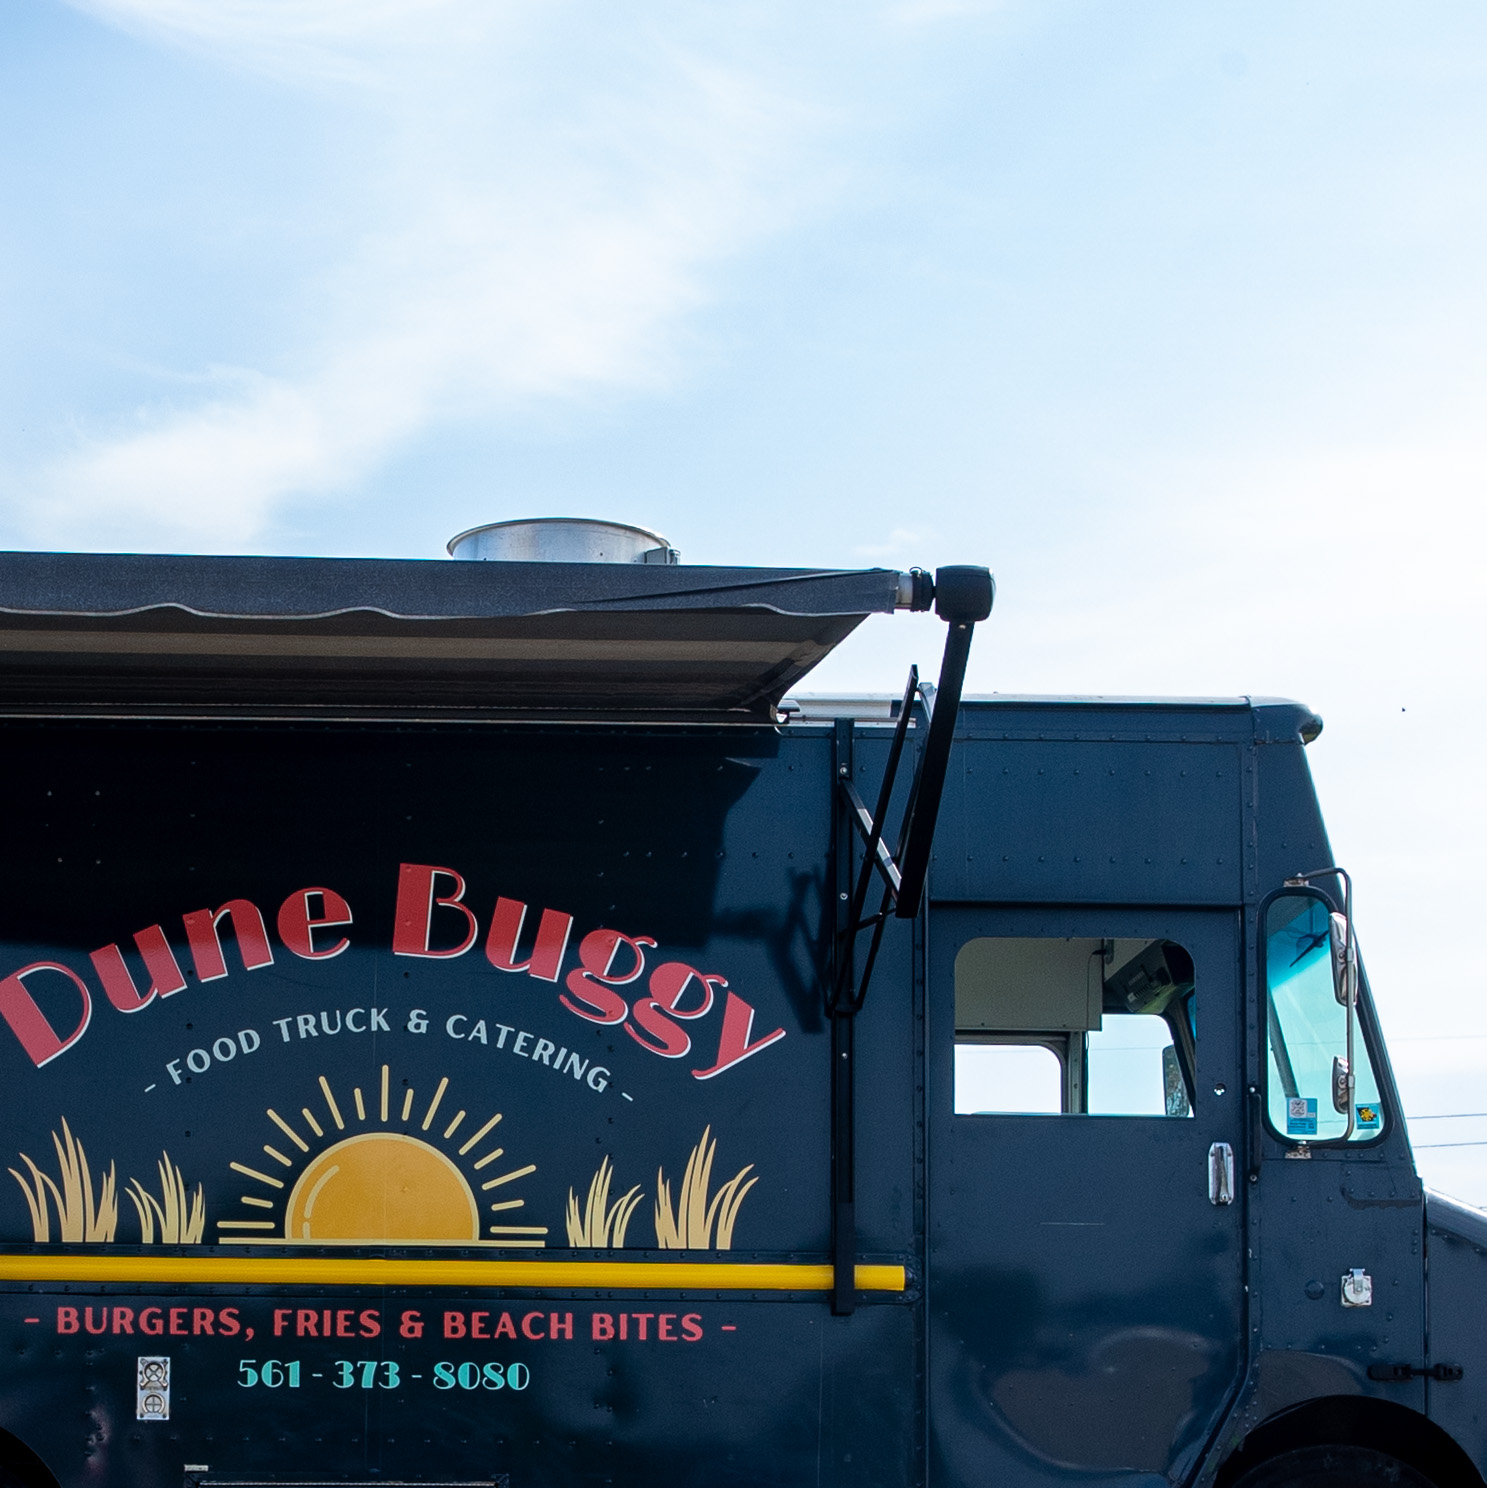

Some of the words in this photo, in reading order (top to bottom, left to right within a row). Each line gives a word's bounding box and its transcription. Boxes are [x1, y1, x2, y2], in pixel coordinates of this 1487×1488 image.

[393, 863, 787, 1080] Buggy
[166, 1030, 260, 1085] FOOD
[273, 1009, 390, 1042] TRUCK
[408, 1009, 429, 1034] &
[445, 1015, 611, 1093] CATERING
[58, 1307, 254, 1341] BURGERS,
[274, 1309, 381, 1337] FRIES
[400, 1311, 425, 1338] &
[444, 1312, 572, 1340] BEACH
[592, 1313, 703, 1341] BITES
